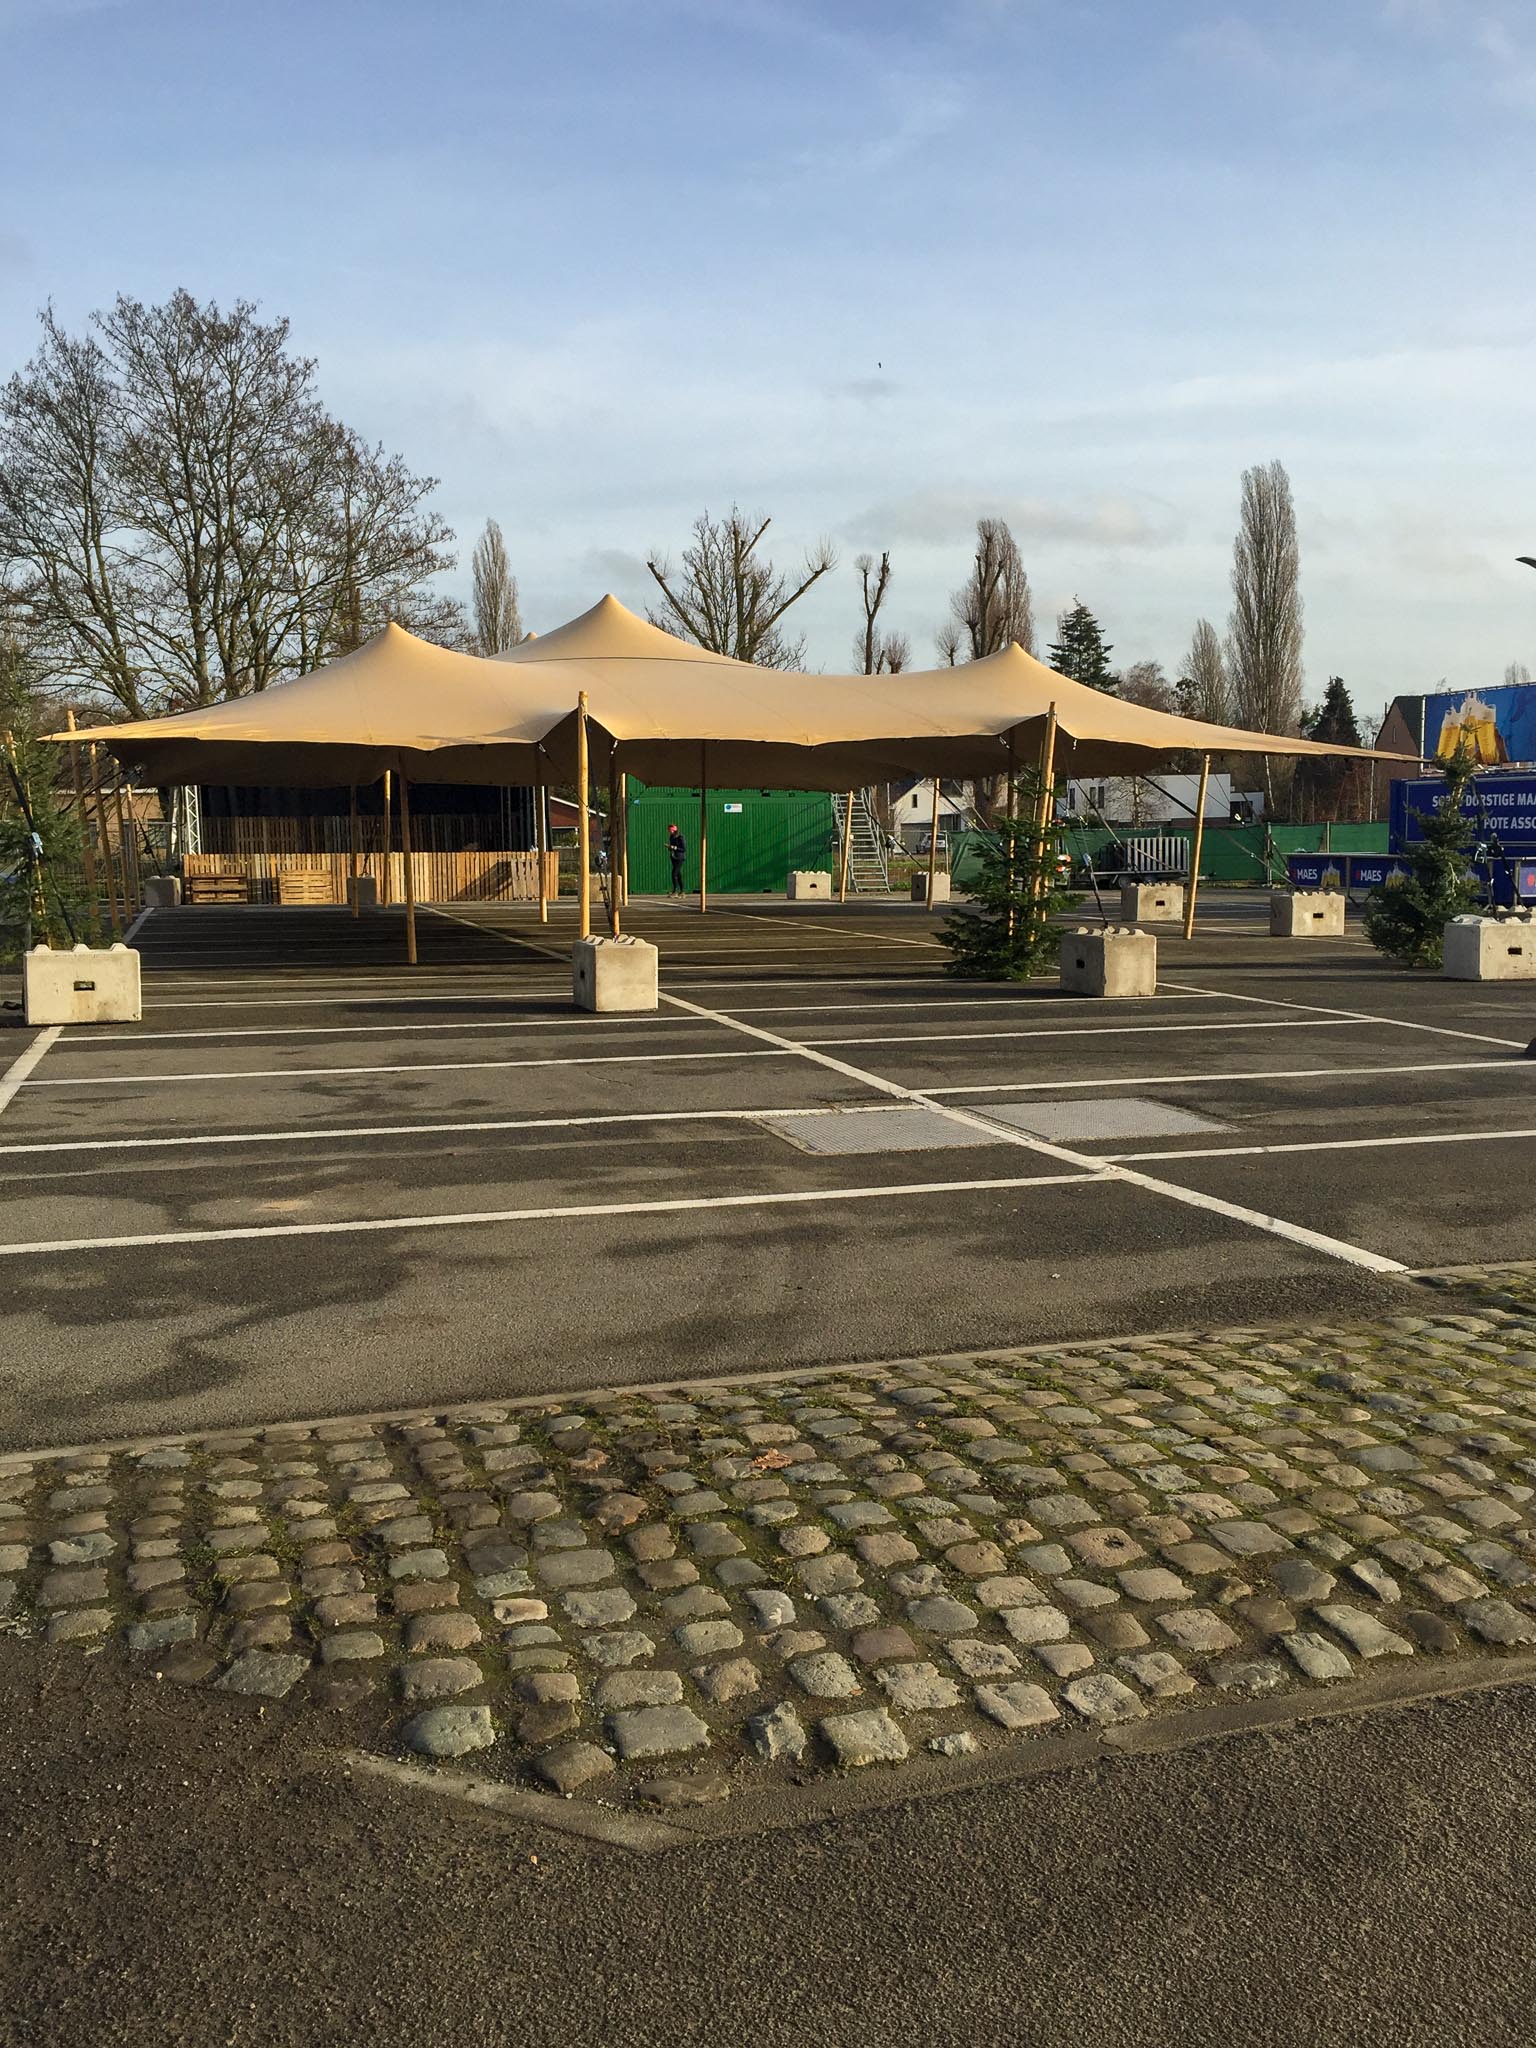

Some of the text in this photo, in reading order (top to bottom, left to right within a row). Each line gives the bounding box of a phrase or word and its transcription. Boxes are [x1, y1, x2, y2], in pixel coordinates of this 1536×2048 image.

[1466, 793, 1515, 806] DORSTIGE
[1483, 816, 1509, 829] POTE
[1297, 869, 1318, 880] MAES
[1360, 870, 1382, 881] MAES
